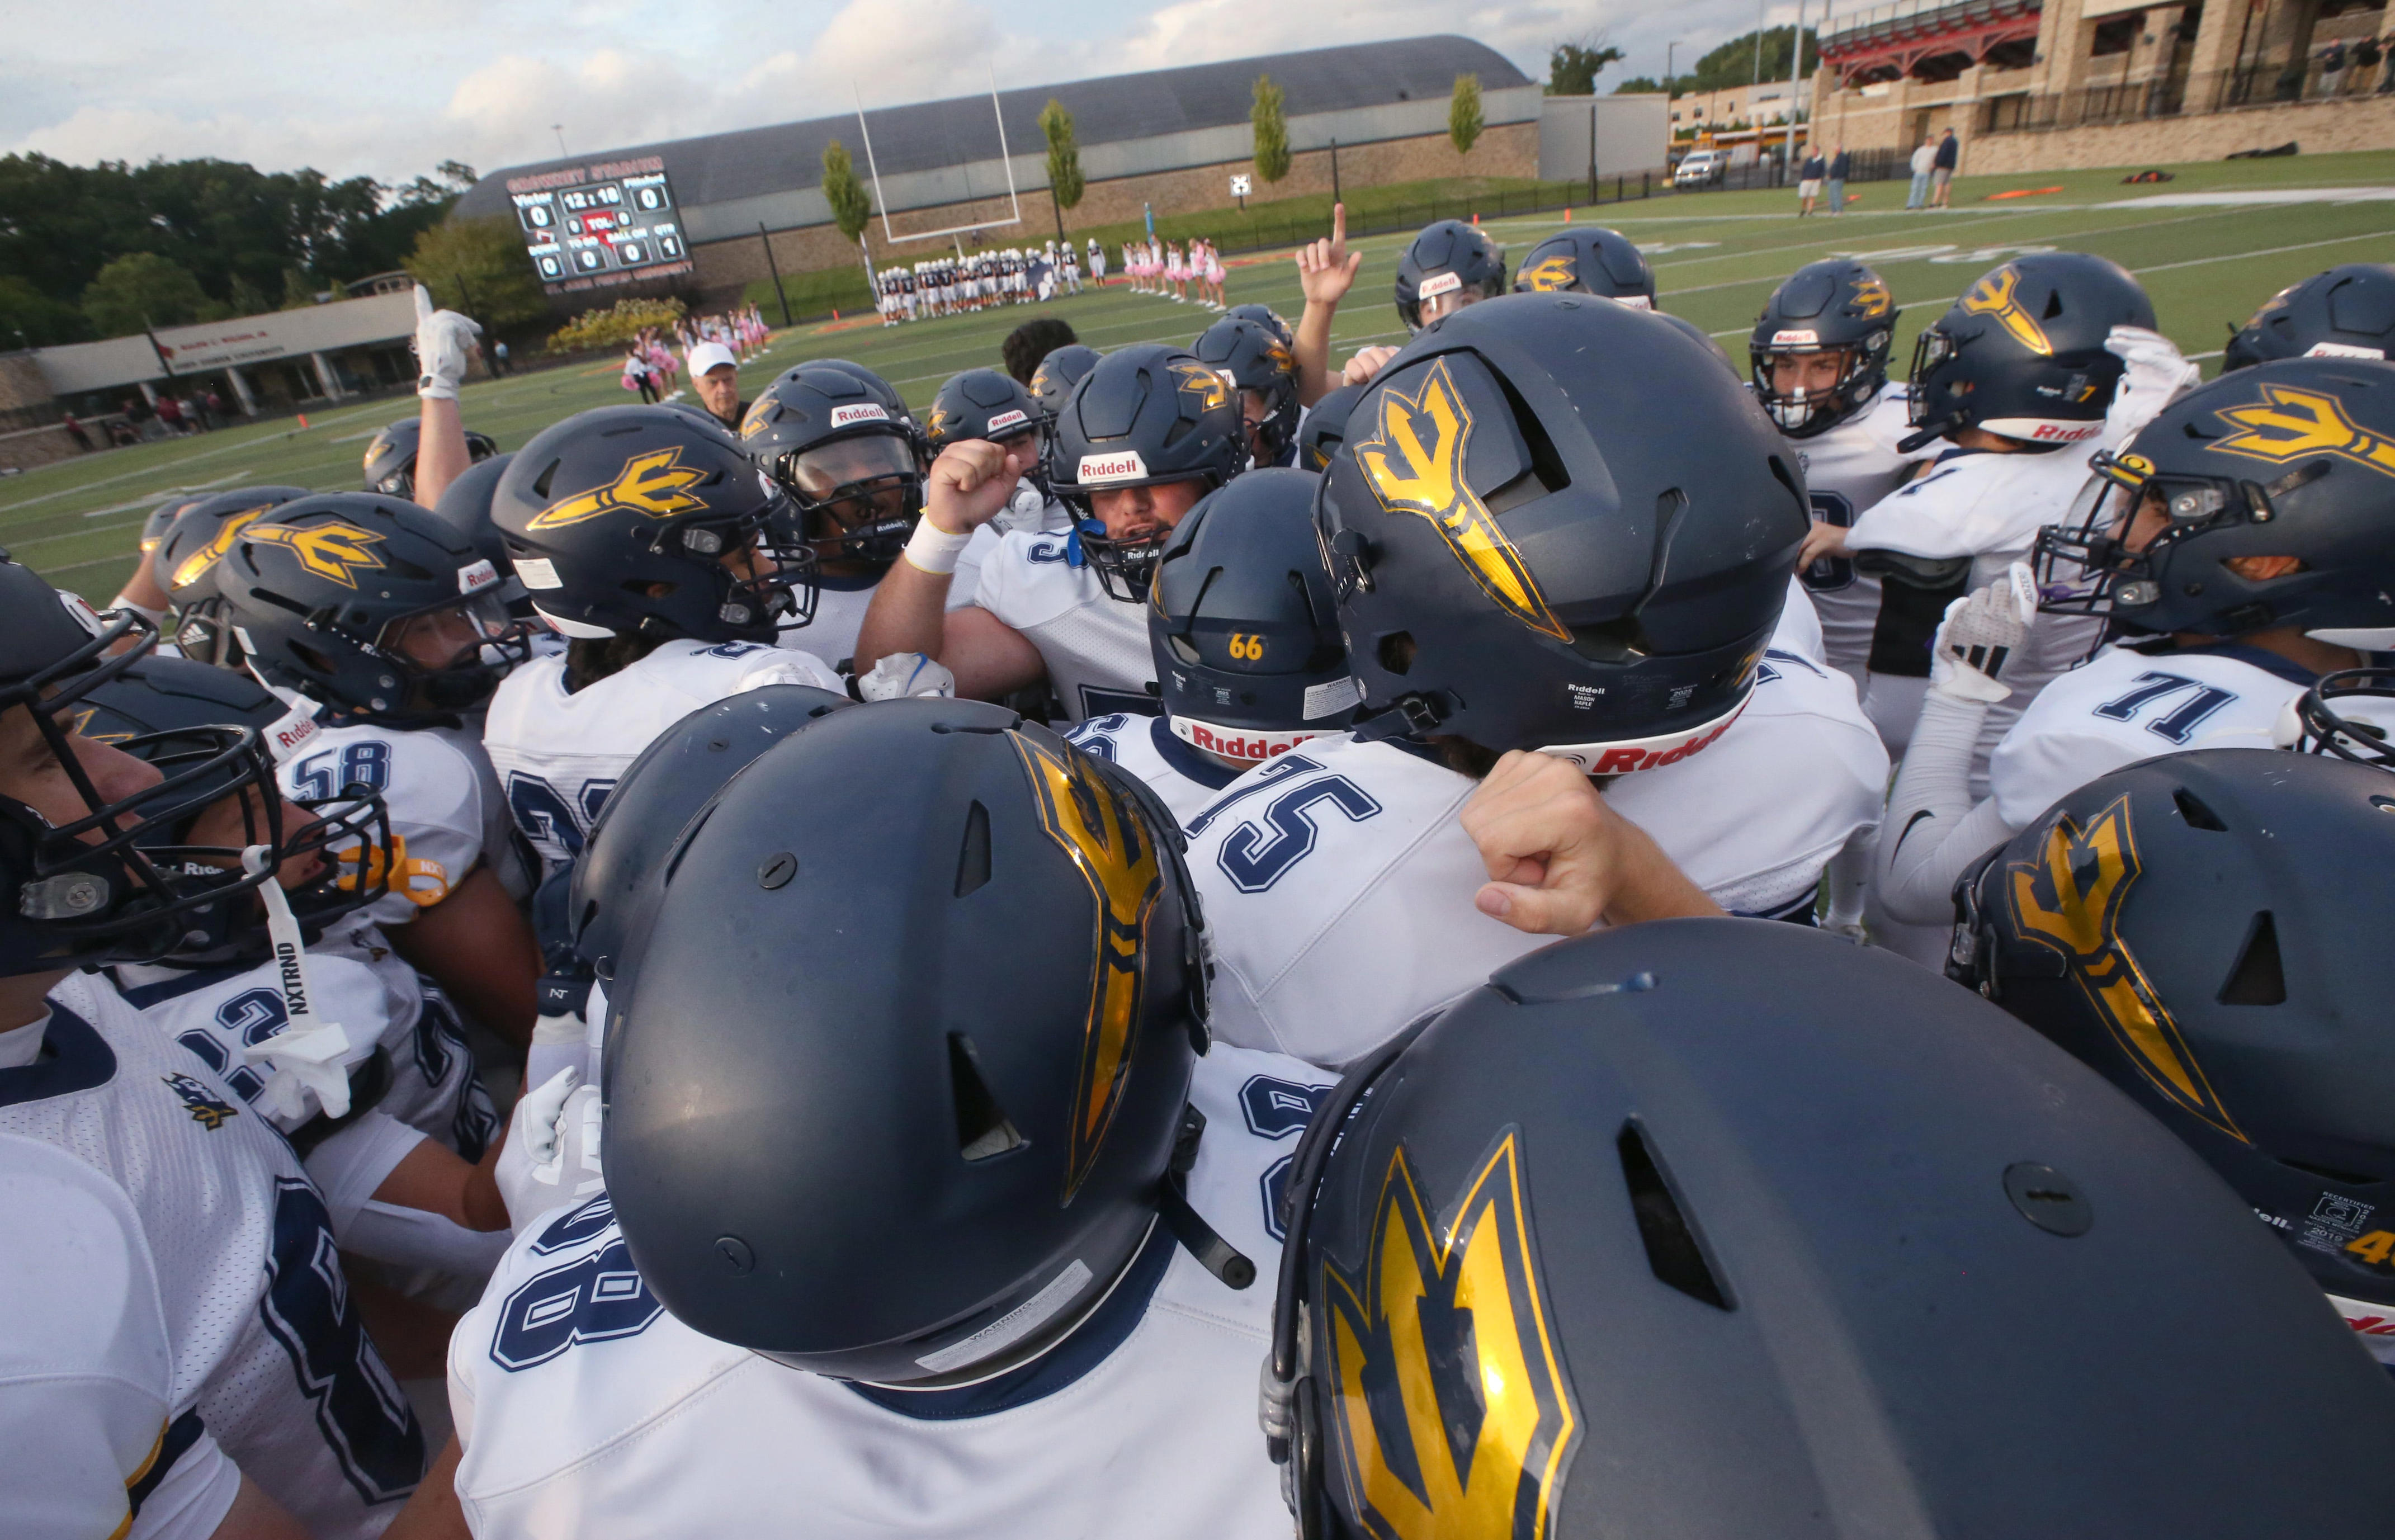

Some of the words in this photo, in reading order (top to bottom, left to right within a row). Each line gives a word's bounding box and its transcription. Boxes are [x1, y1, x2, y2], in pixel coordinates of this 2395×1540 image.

[641, 188, 658, 209] 0
[530, 206, 549, 227] 0
[618, 212, 630, 225] 0
[625, 244, 640, 262] 0
[663, 238, 676, 255] 1
[542, 257, 558, 275] 0
[582, 251, 597, 268] 0
[838, 408, 884, 421] Riddell
[991, 412, 1022, 426] Riddell
[1082, 460, 1136, 476] Riddell
[876, 522, 904, 532] Riddell
[1229, 632, 1263, 661] 66
[1327, 677, 1352, 688] WARNING
[1568, 683, 1605, 695] Riddell
[2092, 670, 2239, 745] 71
[1182, 754, 1383, 894] 75
[277, 942, 309, 1015] NXTRND
[2322, 1191, 2375, 1210] RECERTIFIED
[2311, 1227, 2344, 1242] 2019
[2345, 1230, 2395, 1264] 4
[970, 1302, 1032, 1341] WARNING
